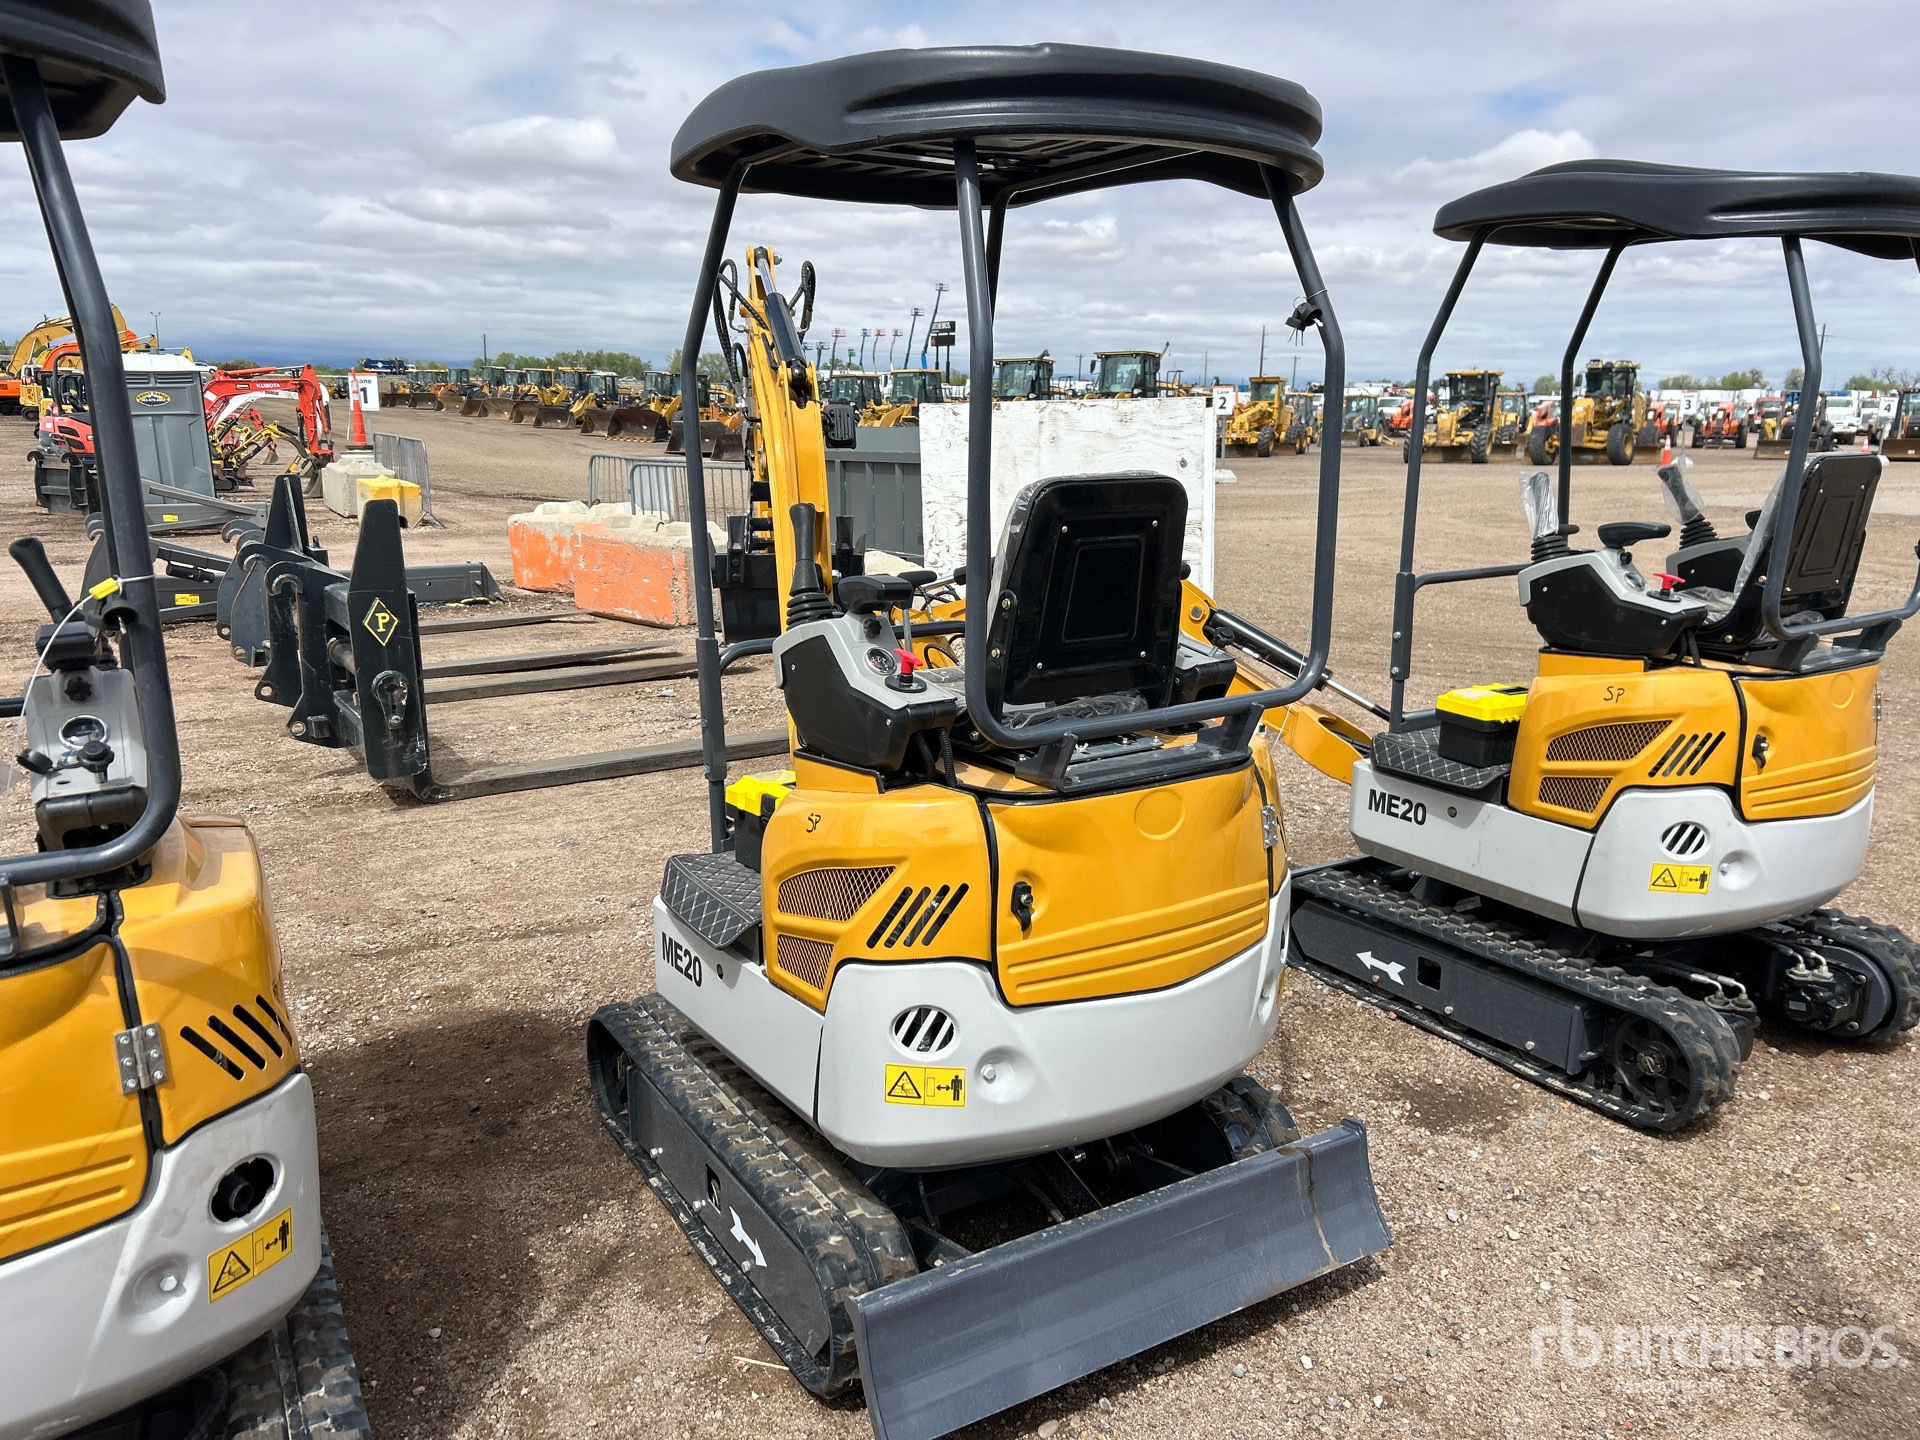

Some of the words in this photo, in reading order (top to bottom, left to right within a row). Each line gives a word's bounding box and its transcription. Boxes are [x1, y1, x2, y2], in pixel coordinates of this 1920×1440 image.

[360, 386, 369, 404] 1
[1218, 396, 1227, 410] 2
[1684, 399, 1692, 410] 3
[1883, 403, 1892, 413] 4
[374, 612, 390, 632] P
[1603, 685, 1626, 704] SP
[1367, 788, 1427, 826] ME20
[661, 930, 703, 988] ME20
